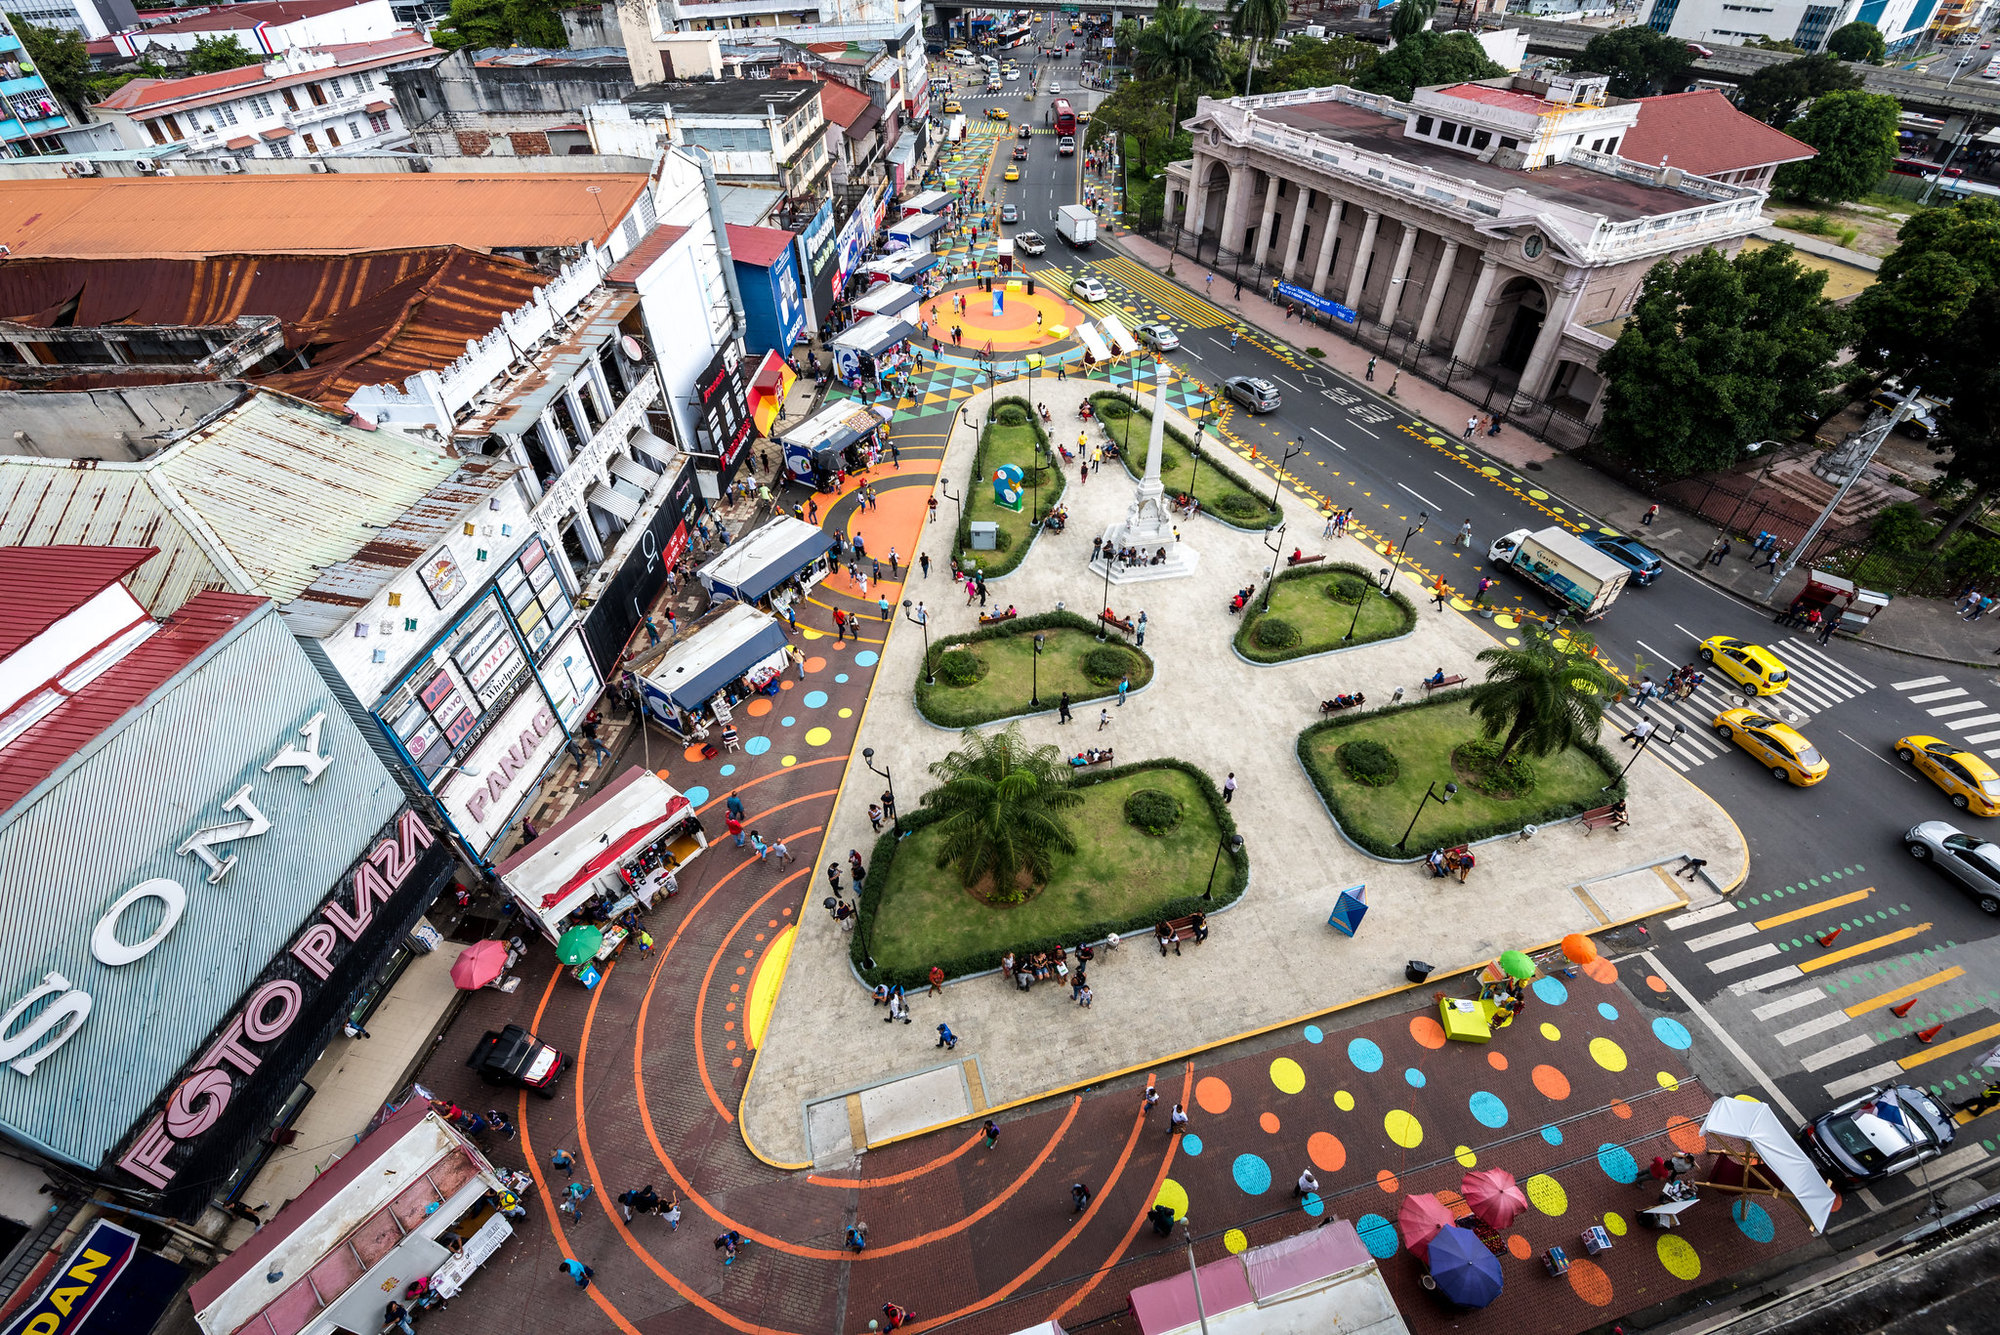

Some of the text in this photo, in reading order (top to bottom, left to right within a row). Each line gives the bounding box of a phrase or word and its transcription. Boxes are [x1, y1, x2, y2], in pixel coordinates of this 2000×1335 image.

[1320, 387, 1362, 406] BUS
[1347, 403, 1395, 424] SOLO
[470, 619, 503, 657] Continental
[472, 637, 512, 688] SANKEY
[485, 657, 523, 700] Whirlpool
[437, 695, 462, 725] SANYO
[451, 711, 474, 743] JVC
[465, 706, 558, 824] PANAC
[0, 711, 333, 1077] SONY
[116, 809, 435, 1191] FOTO PLAZA
[20, 1248, 112, 1335] DAN
